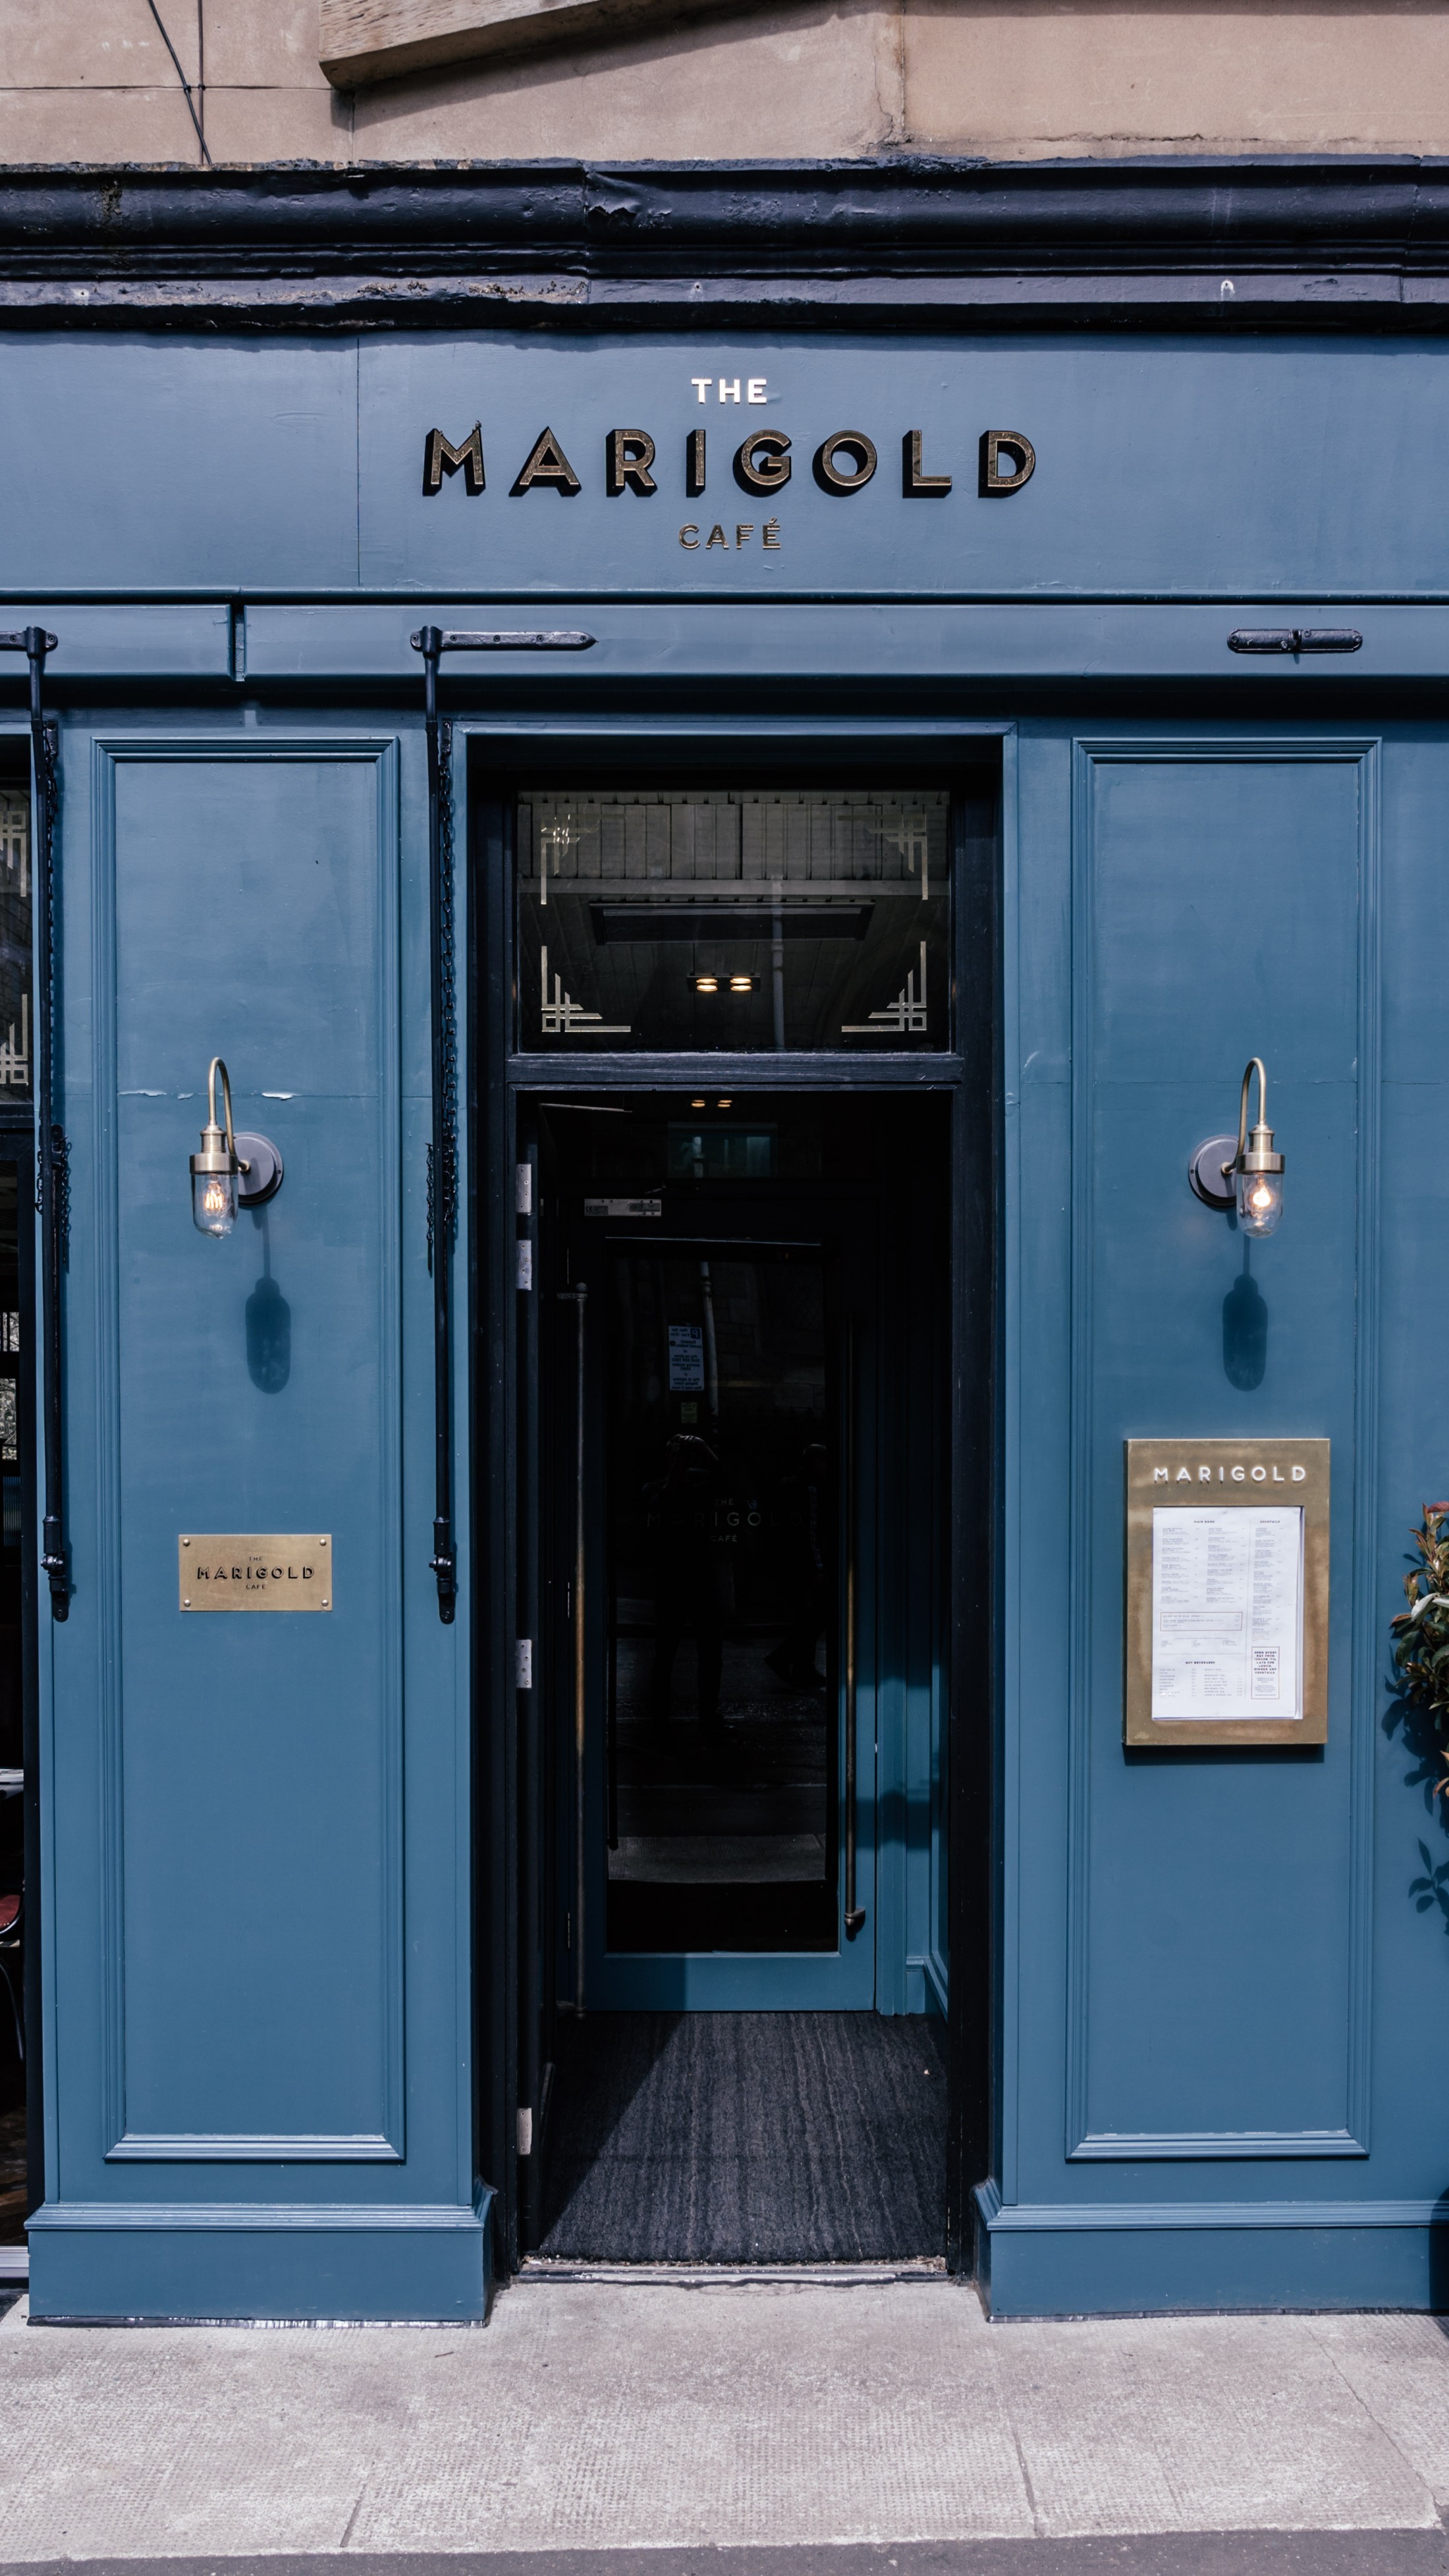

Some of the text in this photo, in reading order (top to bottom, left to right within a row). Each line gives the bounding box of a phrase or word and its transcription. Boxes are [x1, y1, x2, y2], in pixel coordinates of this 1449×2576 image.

[691, 377, 768, 404] THE
[422, 425, 1036, 498] MARIGOLD
[678, 517, 782, 550] CAFÉ
[1153, 1466, 1306, 1482] MARIGOLD
[646, 1512, 803, 1527] MARIGOLD
[197, 1566, 315, 1579] MARIGOLD
